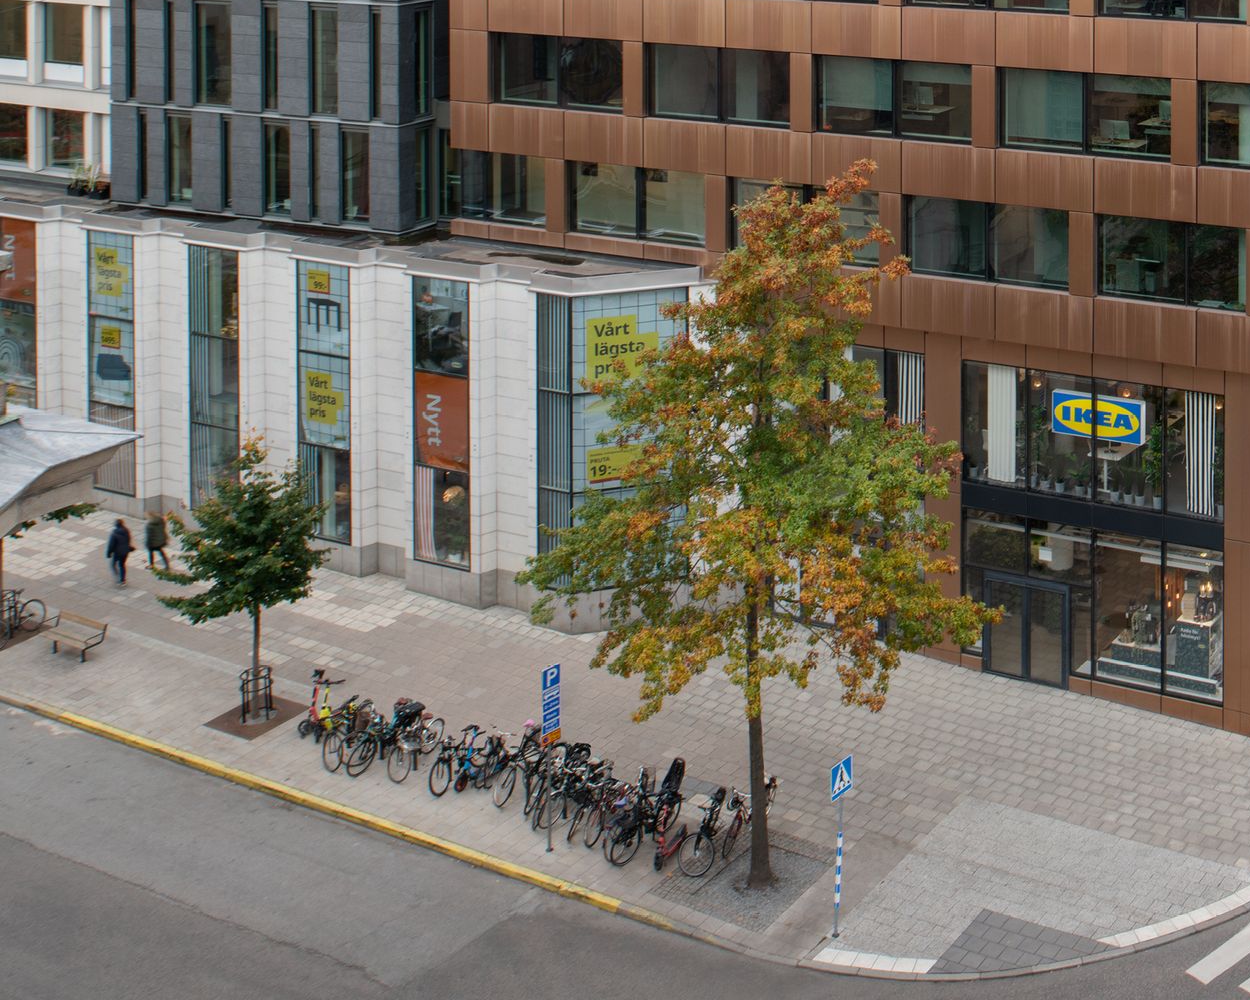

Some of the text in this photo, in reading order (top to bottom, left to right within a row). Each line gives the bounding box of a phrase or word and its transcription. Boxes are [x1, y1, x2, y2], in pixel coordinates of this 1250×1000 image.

[593, 321, 630, 337] Vårt
[595, 341, 645, 358] lägsta
[308, 376, 328, 389] Vårt
[309, 391, 337, 406] lägsta
[309, 407, 327, 418] pris
[422, 393, 442, 447] Nytt
[1062, 405, 1133, 430] IKEA
[546, 667, 558, 687] P
